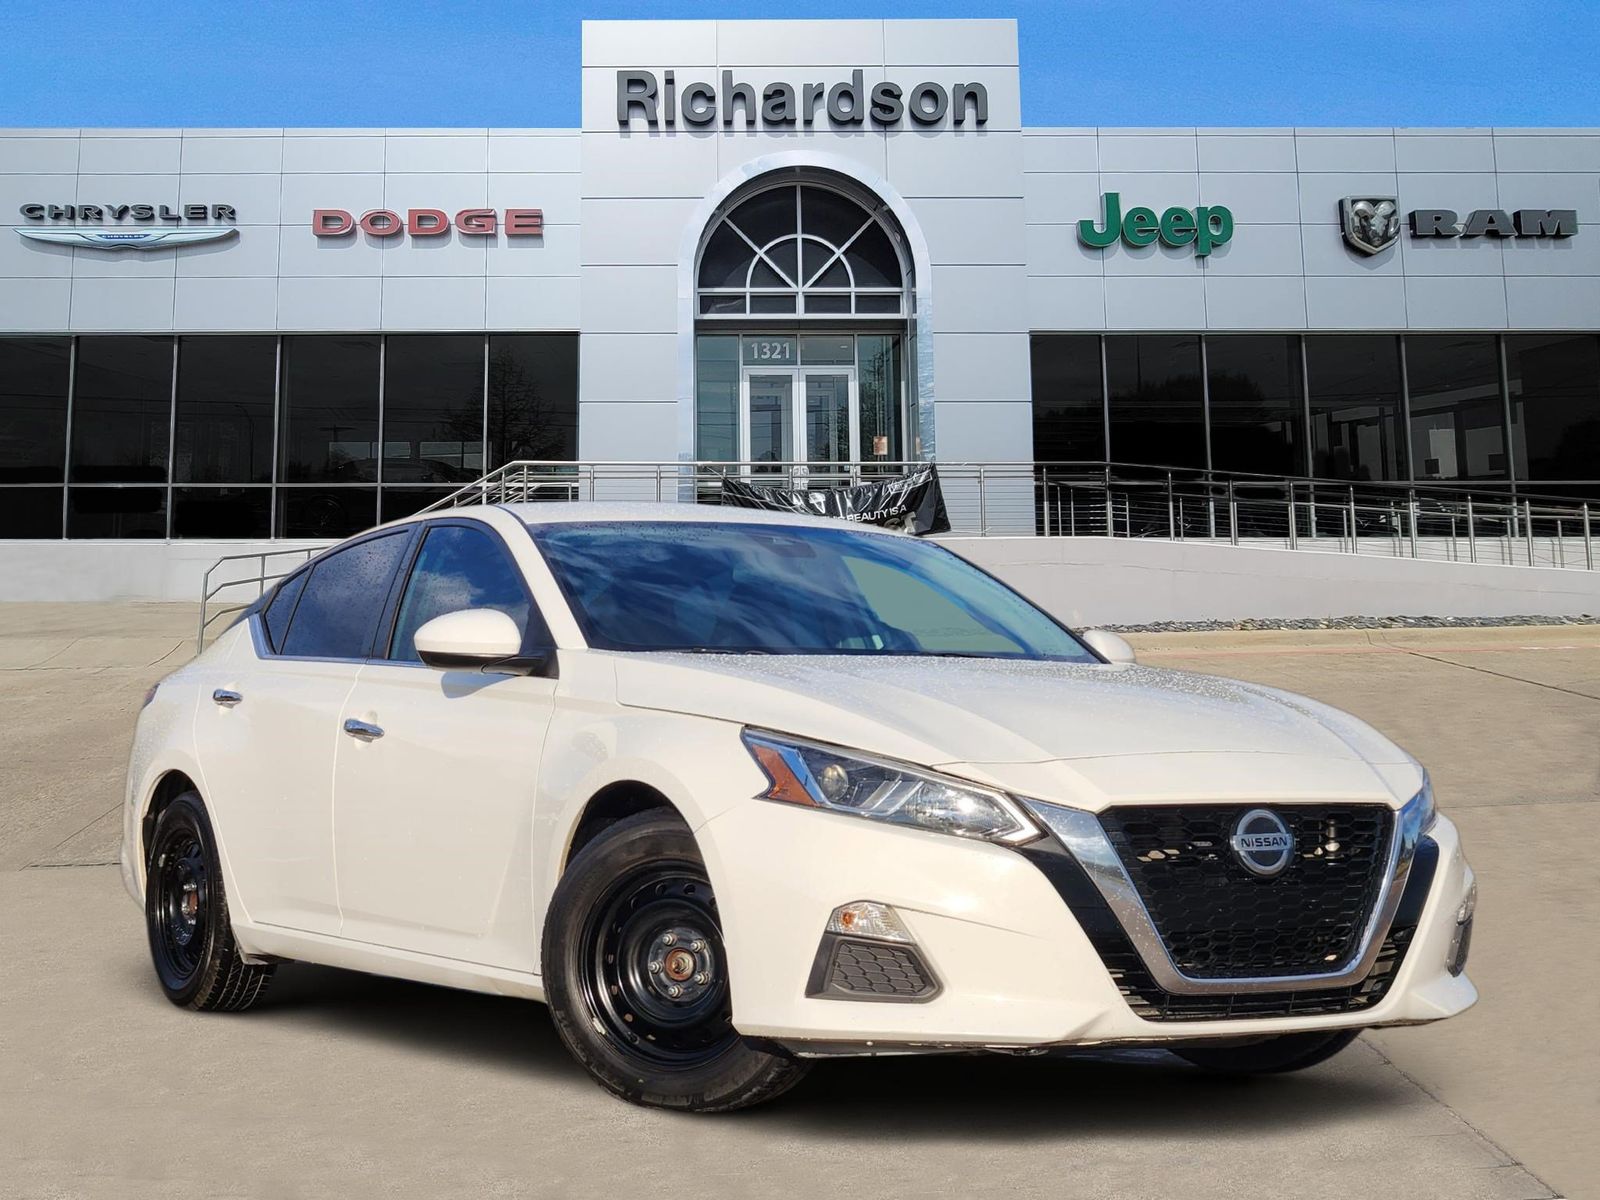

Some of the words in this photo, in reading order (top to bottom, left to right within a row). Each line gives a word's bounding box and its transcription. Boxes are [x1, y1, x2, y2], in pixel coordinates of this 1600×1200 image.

[616, 69, 989, 126] Richardson
[20, 203, 236, 221] CHRYSLER
[312, 208, 544, 237] DODGE
[1410, 209, 1577, 238] RAM
[1078, 192, 1234, 256] Jeep
[751, 342, 790, 359] 1321
[847, 507, 888, 522] BEAUTY
[890, 506, 899, 515] IS
[900, 504, 907, 513] A
[1241, 837, 1288, 848] NISSAN
